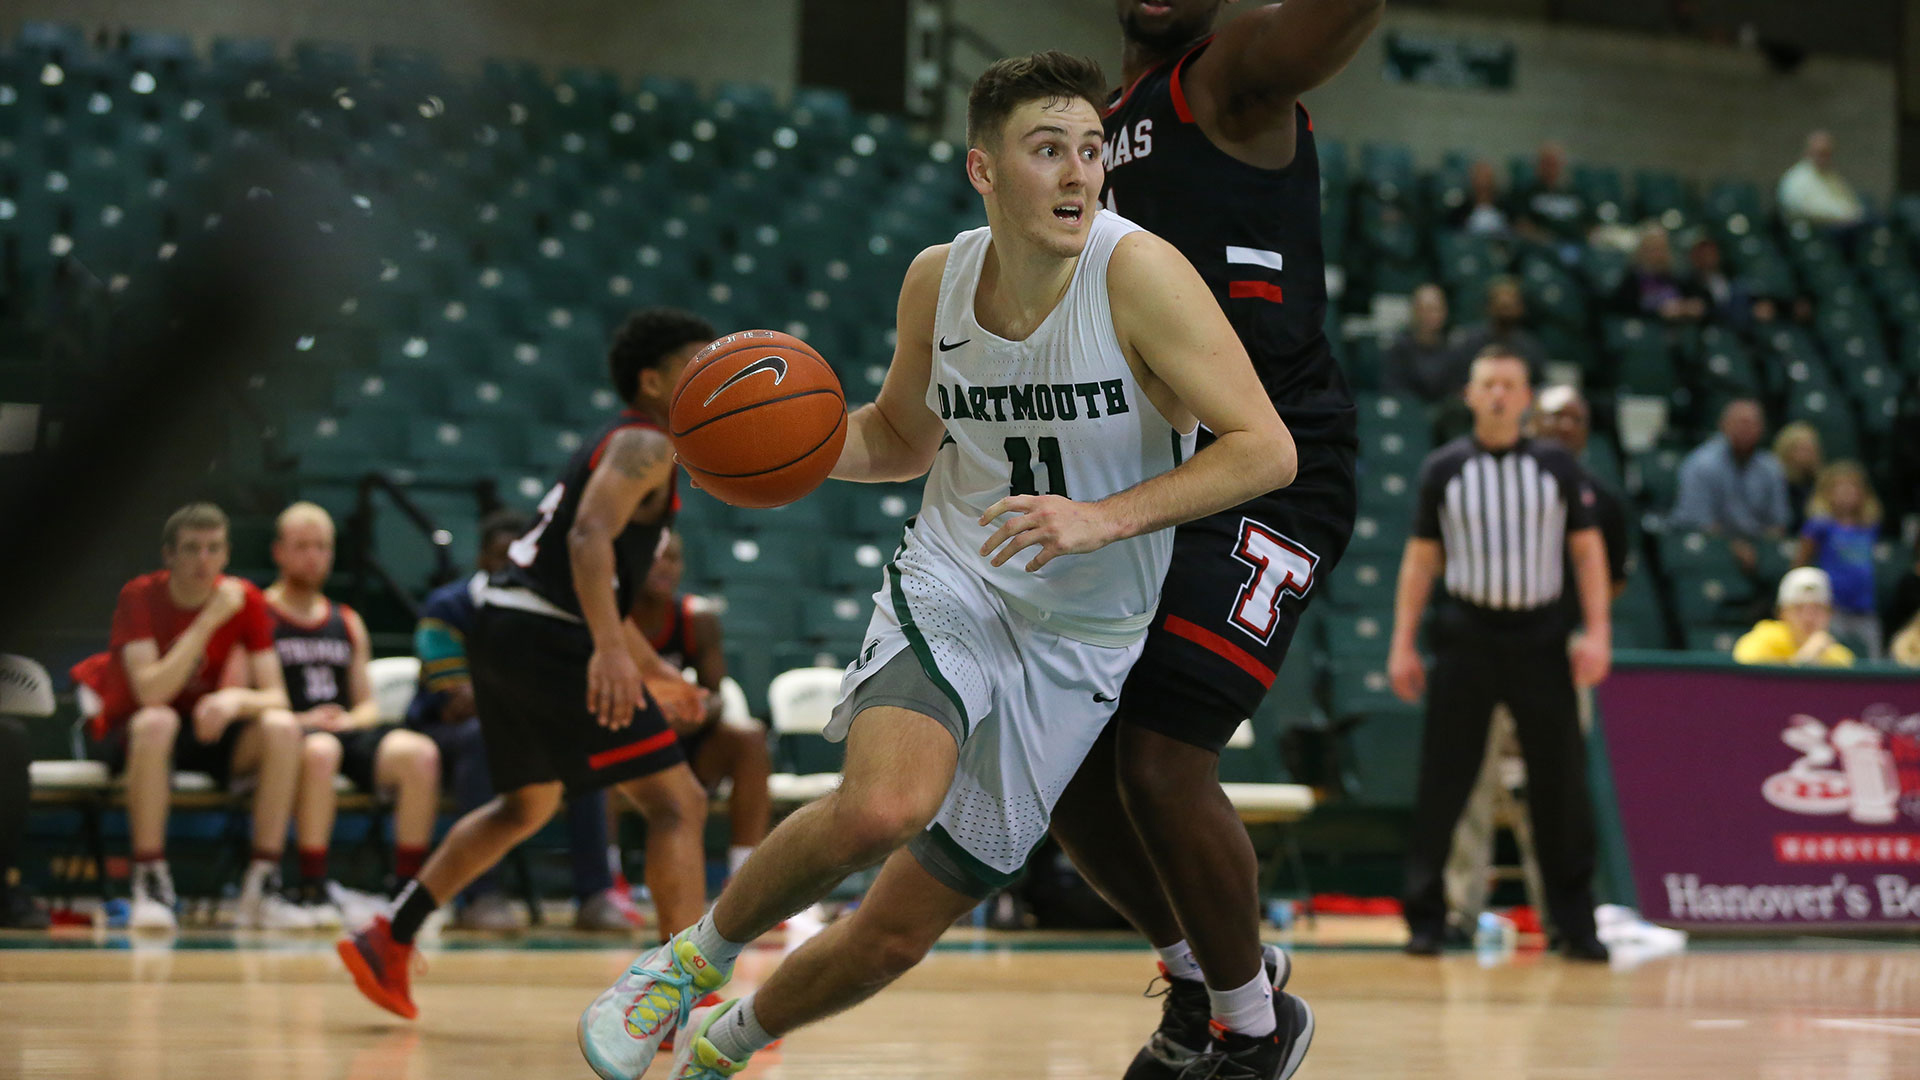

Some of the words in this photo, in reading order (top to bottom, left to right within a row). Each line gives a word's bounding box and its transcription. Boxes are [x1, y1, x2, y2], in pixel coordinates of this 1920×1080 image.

[937, 378, 1130, 422] DARTMOUTH
[1003, 436, 1073, 501] 11
[1227, 516, 1320, 646] T
[1664, 872, 1872, 920] Hanover's
